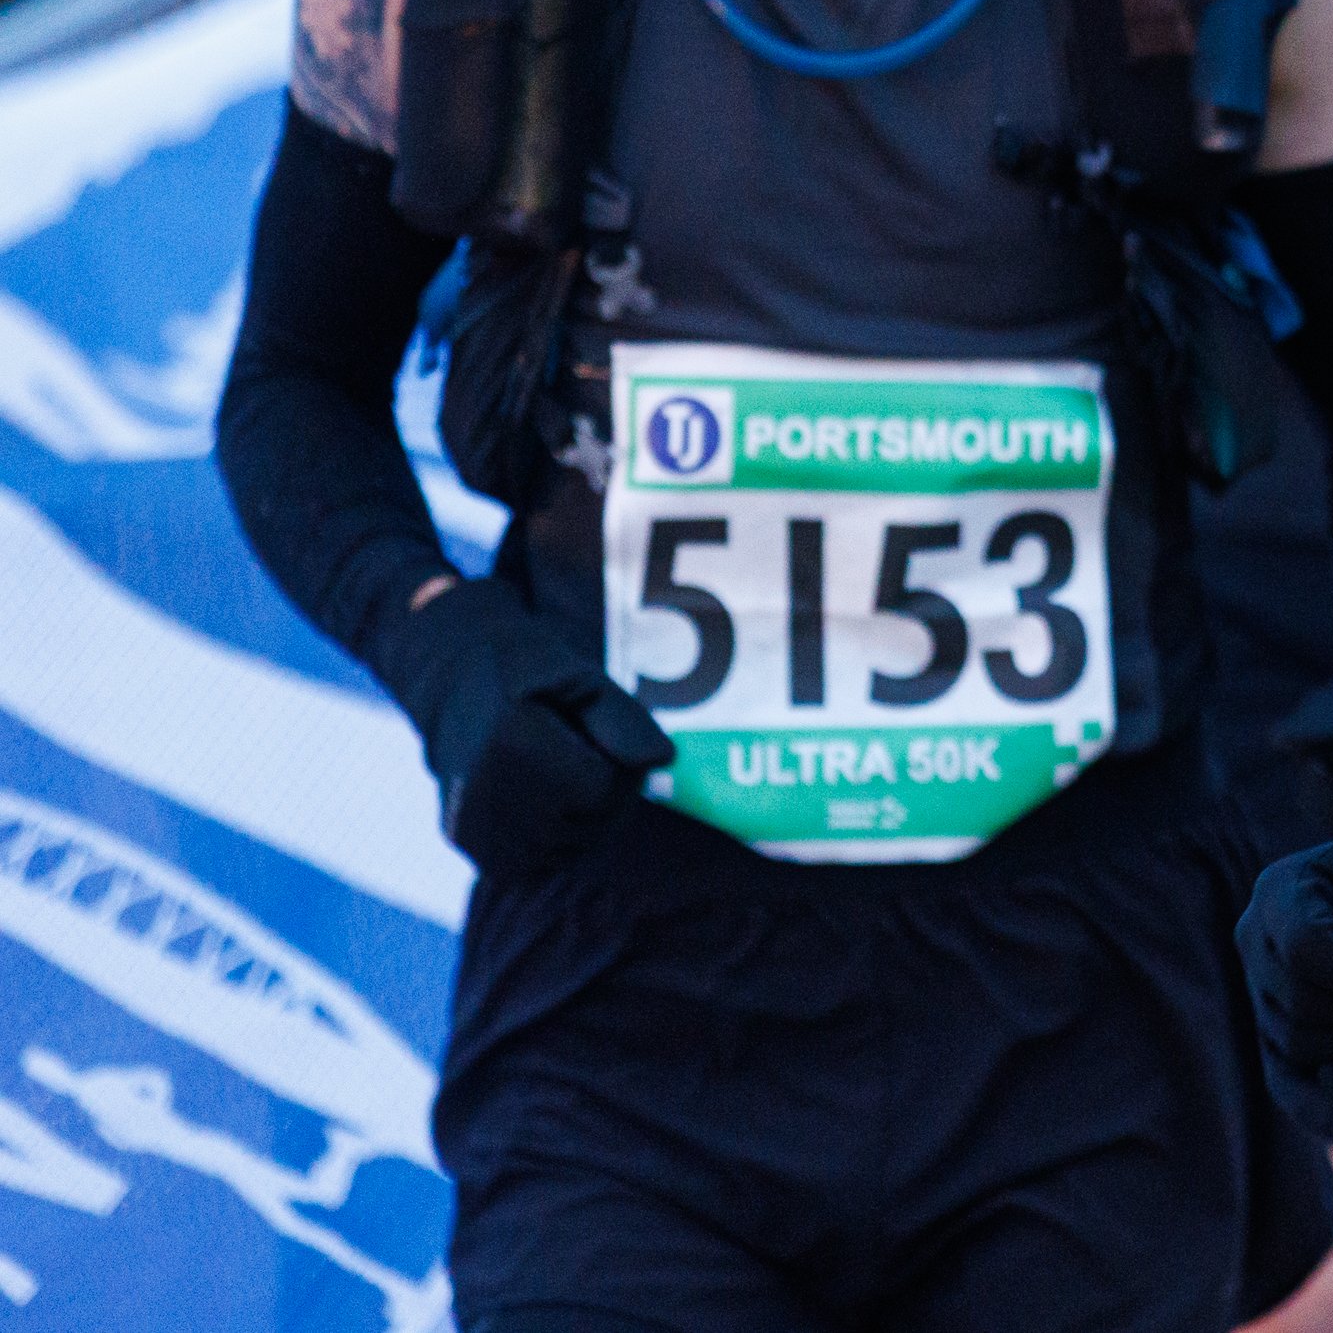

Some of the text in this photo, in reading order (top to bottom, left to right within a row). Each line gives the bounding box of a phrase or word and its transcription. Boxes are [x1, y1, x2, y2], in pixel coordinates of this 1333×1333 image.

[743, 414, 1087, 464] PORTSMOUTH
[634, 509, 1088, 709] 5153
[728, 739, 1002, 786] ULTRA 50K
